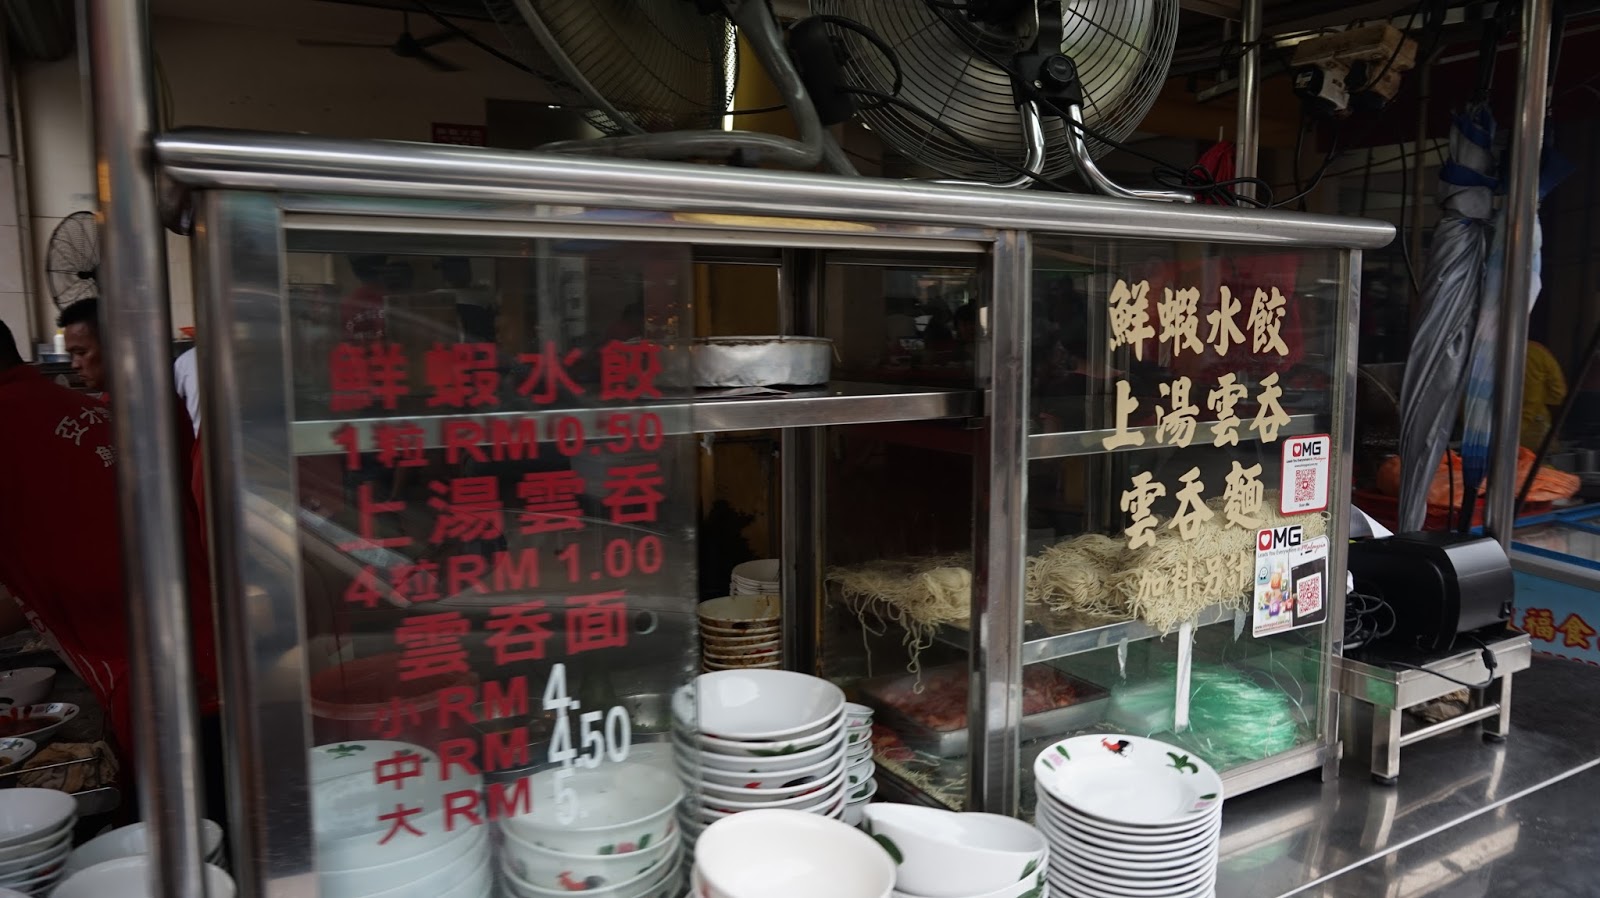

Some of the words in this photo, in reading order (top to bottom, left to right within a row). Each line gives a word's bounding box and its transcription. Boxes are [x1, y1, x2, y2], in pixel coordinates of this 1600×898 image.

[1109, 279, 1289, 361] 鮮蝦水餃
[329, 340, 664, 412] 鮮蝦水餃
[1102, 371, 1291, 451] 上湯雲吞
[336, 463, 665, 551] 上湯雲吞
[1120, 460, 1264, 550] 雲吞麵
[394, 590, 629, 681] 雲吞面
[371, 697, 421, 738] 小
[437, 676, 529, 728] RM
[374, 750, 422, 790] 中
[438, 727, 530, 781] RM
[548, 706, 631, 769] 4.50
[377, 803, 425, 845] 大
[442, 777, 533, 832] RM
